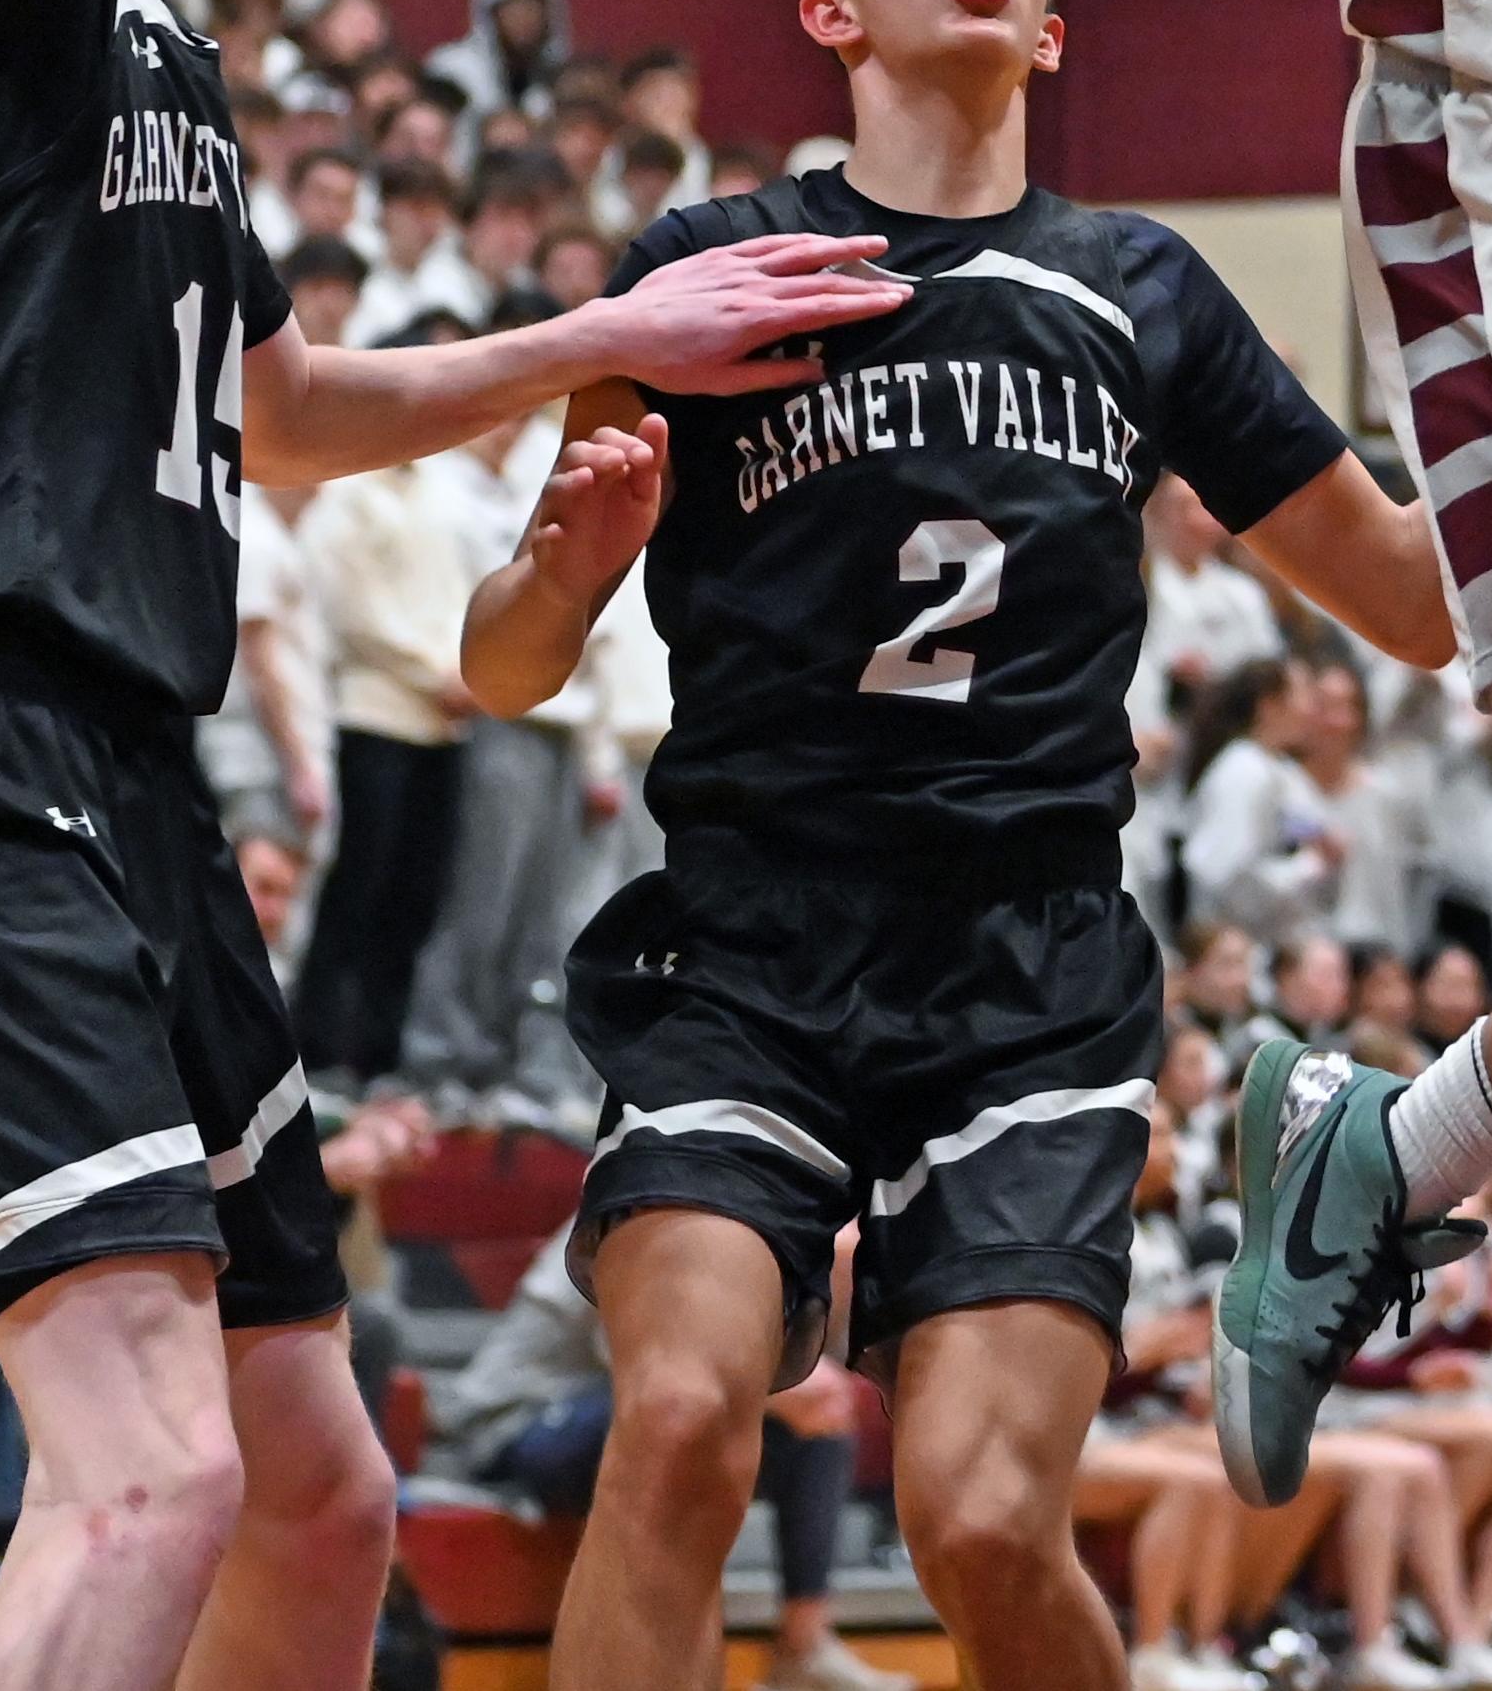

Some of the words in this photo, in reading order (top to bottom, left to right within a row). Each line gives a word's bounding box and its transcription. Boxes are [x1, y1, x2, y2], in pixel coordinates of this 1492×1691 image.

[100, 110, 225, 213] GARNET
[735, 361, 929, 515] GARNET
[946, 360, 1140, 503] VALLEY
[857, 518, 1007, 704] 2
